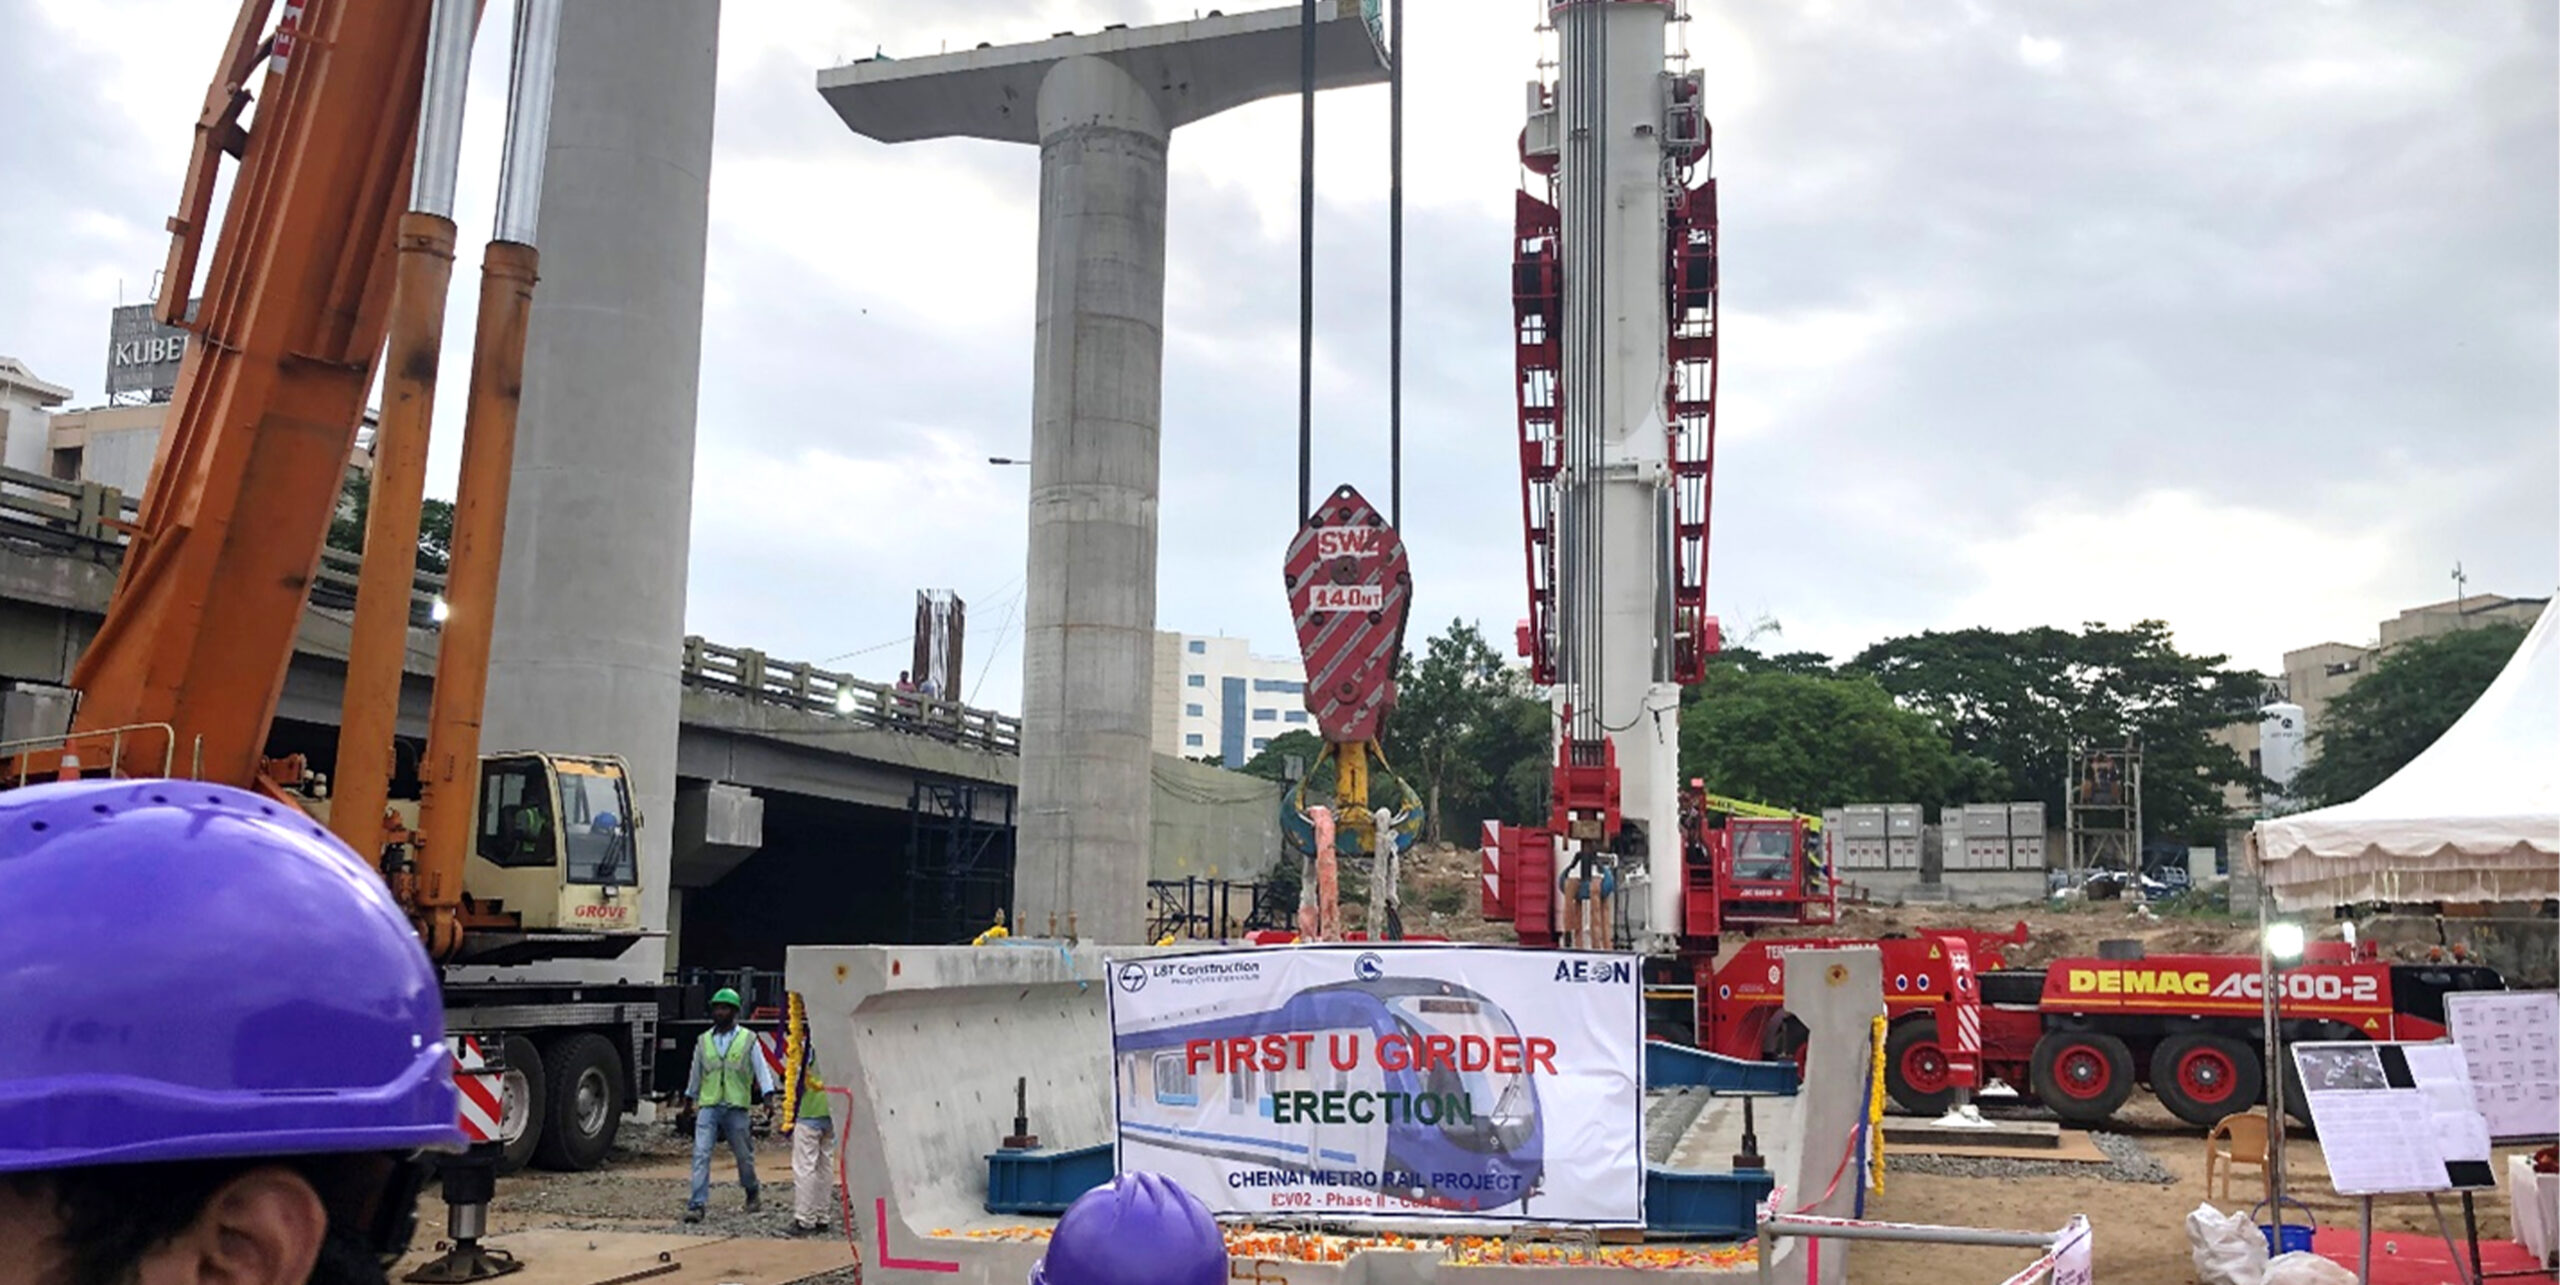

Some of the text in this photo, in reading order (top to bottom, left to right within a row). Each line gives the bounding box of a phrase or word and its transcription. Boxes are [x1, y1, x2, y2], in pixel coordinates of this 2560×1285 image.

[574, 905, 628, 919] GROVE
[1152, 962, 1260, 977] L&T Construction
[2068, 969, 2210, 994] DEMAG
[1185, 1034, 1558, 1075] FIRST U GIRDER
[1273, 1090, 1473, 1125] ERECTION
[1228, 1170, 1522, 1190] CHENNAI METRO RAIL PROJECT
[1326, 1192, 1372, 1207] Phase
